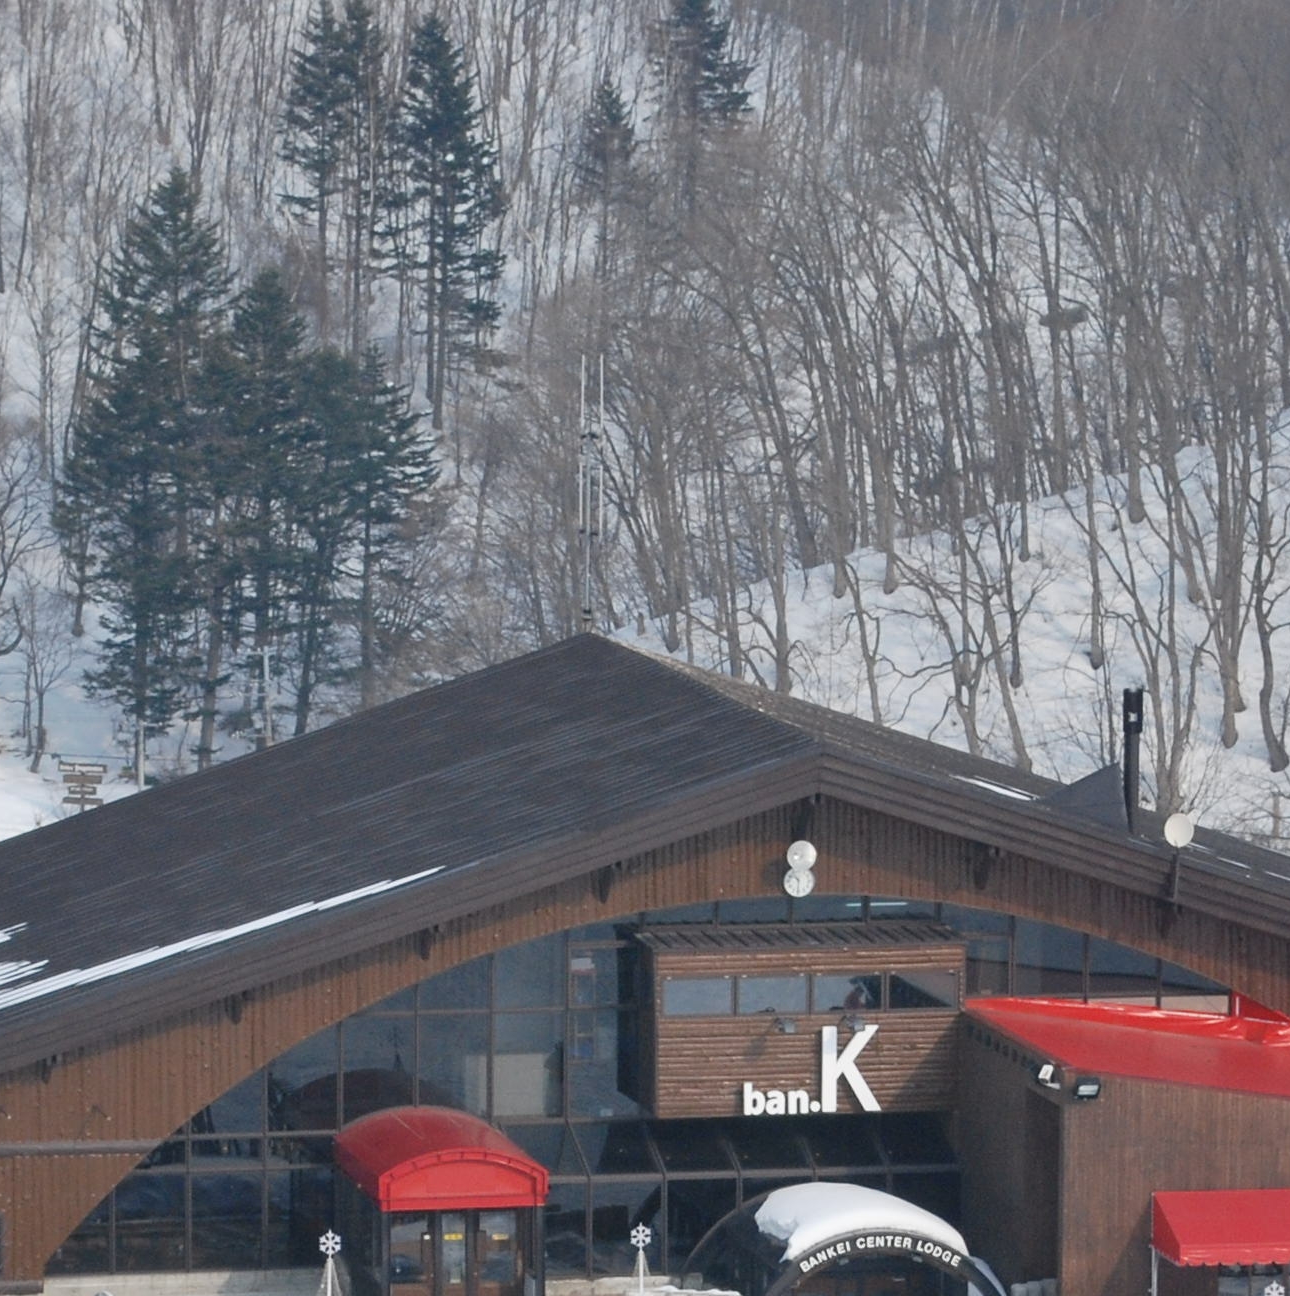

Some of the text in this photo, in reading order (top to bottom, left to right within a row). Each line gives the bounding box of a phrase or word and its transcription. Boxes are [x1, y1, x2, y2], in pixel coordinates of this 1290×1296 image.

[743, 1024, 882, 1116] ban.K
[799, 1235, 962, 1273] BANKEI CENTER LODGE
